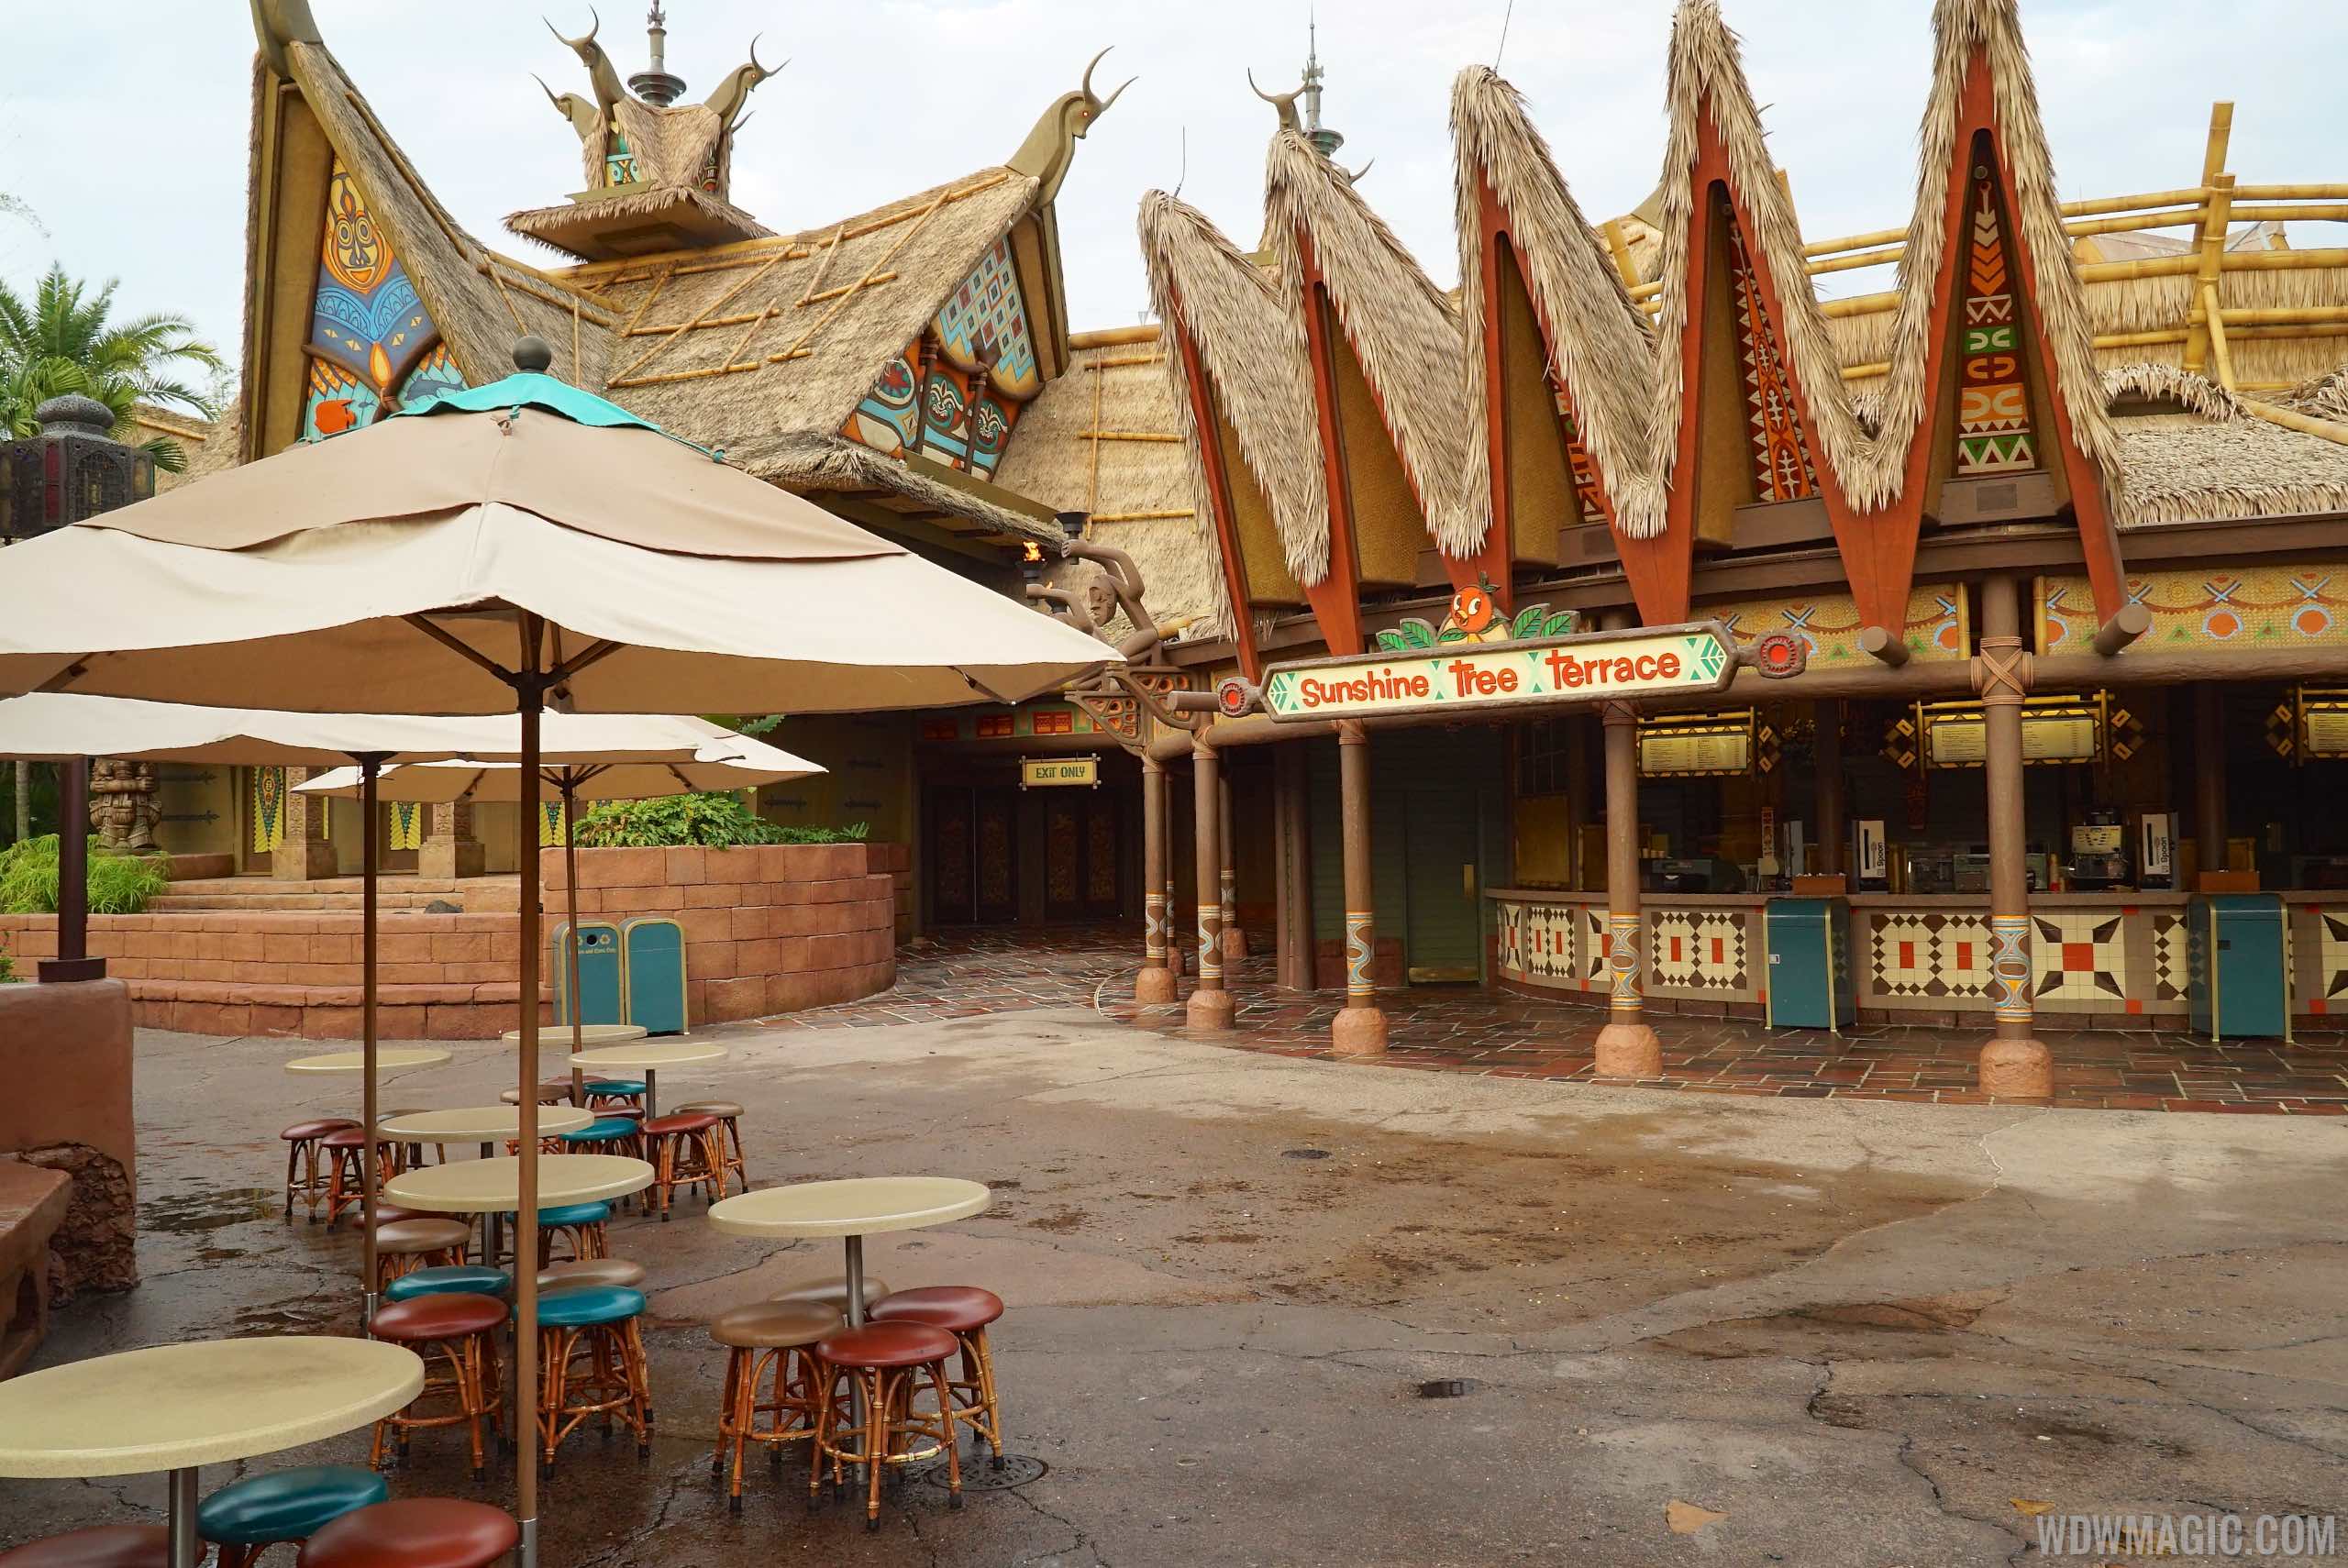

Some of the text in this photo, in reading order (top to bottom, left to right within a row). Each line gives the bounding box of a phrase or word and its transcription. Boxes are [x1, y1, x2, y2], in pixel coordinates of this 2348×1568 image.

[1301, 648, 1681, 709] Sunshine Tree Terrace
[1060, 766, 1086, 778] ONLY
[1877, 842, 1886, 867] Spoon
[2160, 836, 2171, 864] Spoon
